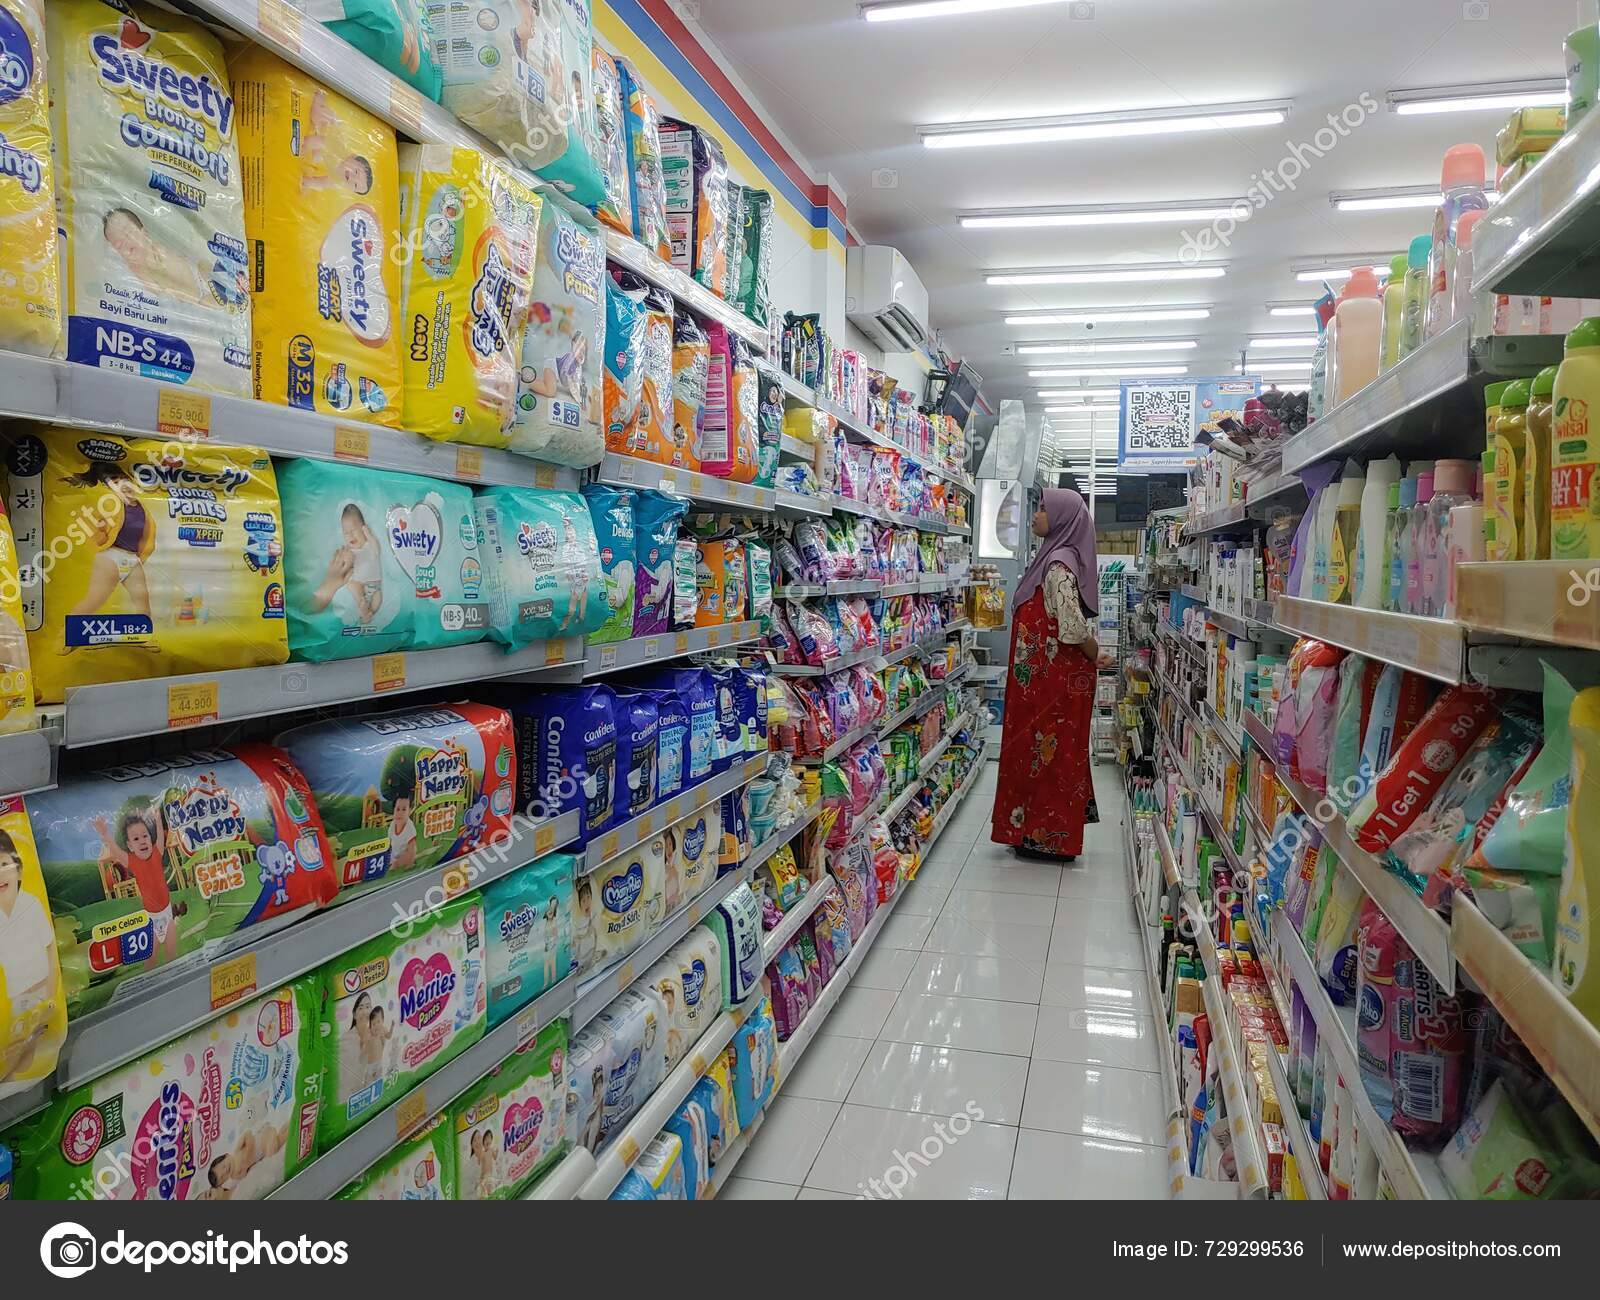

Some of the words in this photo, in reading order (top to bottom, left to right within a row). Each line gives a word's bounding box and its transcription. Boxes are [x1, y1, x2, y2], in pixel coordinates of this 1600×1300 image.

[92, 35, 233, 135] Sweety
[530, 80, 543, 98] 28
[145, 99, 205, 142] Bronze
[120, 112, 229, 187] Comfort
[151, 150, 168, 163] TIPE
[168, 155, 202, 177] PEREKAT
[350, 218, 371, 331] Sweety
[99, 299, 122, 316] Bayi
[124, 307, 145, 321] Baru
[146, 311, 168, 326] Lahir
[96, 326, 157, 362] NB-S
[159, 349, 182, 369] 44
[411, 313, 429, 362] New
[298, 340, 311, 363] M
[297, 370, 311, 395] 32
[168, 405, 204, 423] 55.900
[552, 401, 561, 416] S
[566, 410, 577, 424] 32
[1556, 421, 1588, 439] witsal
[15, 440, 30, 473] XXL
[89, 439, 121, 452] BARU
[1575, 470, 1583, 486] 1
[17, 488, 30, 509] XL
[168, 486, 217, 502] Bronze
[1574, 488, 1582, 505] 1
[168, 498, 228, 523] Pants
[194, 516, 218, 526] CELANA
[17, 532, 30, 543] L
[392, 527, 437, 556] Sweety
[518, 526, 558, 554] Sweety
[443, 608, 462, 622] NB-S
[465, 607, 478, 622] 40
[82, 620, 121, 636] XXL
[123, 624, 148, 635] 18+2
[178, 695, 213, 713] 44.900
[1451, 714, 1475, 738] 50
[416, 752, 463, 779] Happy
[547, 716, 565, 816] Confidenc
[423, 774, 468, 799] Nappy
[522, 764, 532, 800] SERAP
[1391, 784, 1422, 817] Get
[1407, 769, 1430, 785] 1
[164, 791, 230, 830] Happy
[426, 805, 456, 824] Smart
[184, 815, 246, 845] Nappy
[353, 845, 366, 857] Tipe
[366, 841, 385, 853] Celana
[349, 861, 360, 879] M
[368, 858, 384, 873] 34
[99, 922, 118, 936] Tipe
[118, 915, 144, 930] Celana
[500, 904, 537, 937] Sweety
[102, 946, 114, 964] L
[128, 932, 148, 956] 30
[363, 959, 385, 975] Allergy
[364, 970, 385, 985] Tested
[220, 970, 251, 992] 44.900
[1415, 962, 1431, 1017] GRATIS
[399, 970, 456, 1024] Merries
[418, 1002, 441, 1030] Pants
[1417, 1018, 1445, 1039] 1
[303, 1074, 319, 1098] 34
[369, 1085, 378, 1102] L
[106, 1105, 114, 1139] TERUJI
[303, 1101, 319, 1124] M
[152, 1081, 181, 1199] erries
[503, 1110, 544, 1152] Merries
[178, 1120, 195, 1181] Pants
